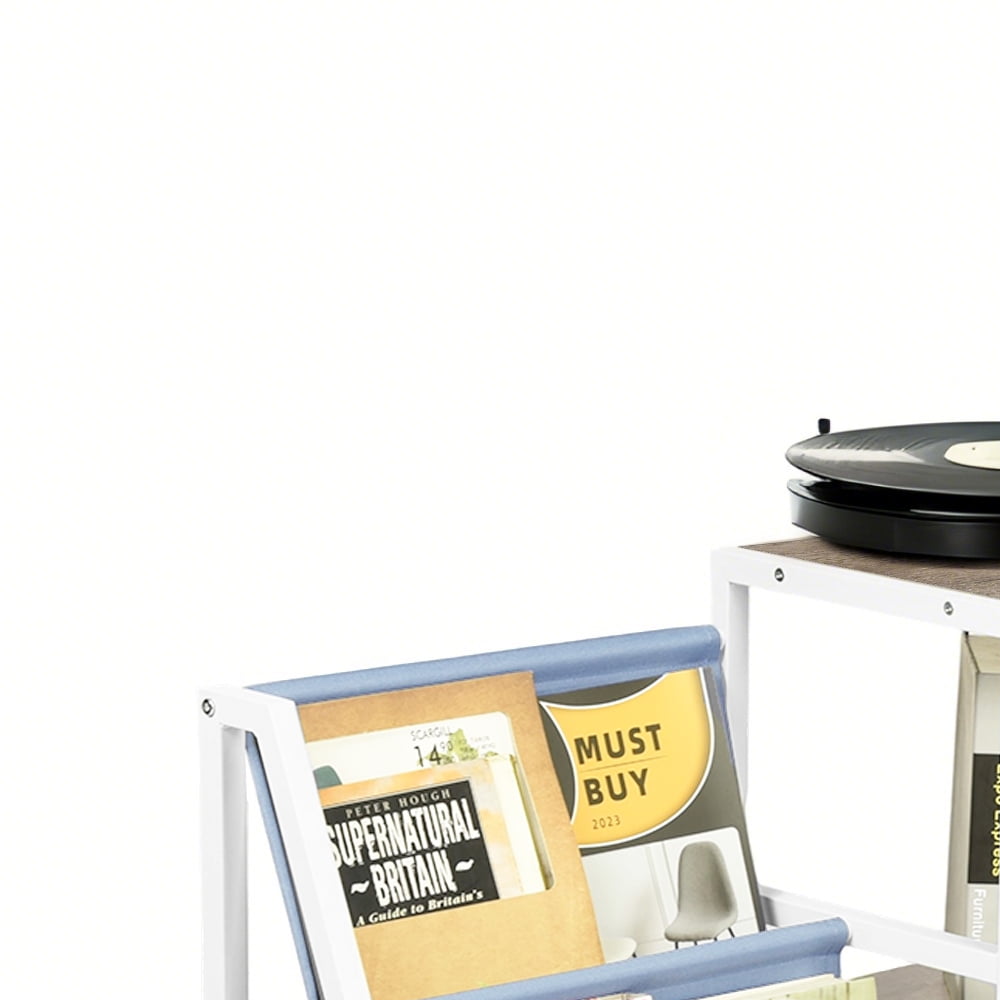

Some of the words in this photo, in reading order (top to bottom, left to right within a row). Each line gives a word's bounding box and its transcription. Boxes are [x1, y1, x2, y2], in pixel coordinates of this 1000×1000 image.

[574, 723, 661, 765] MUST
[345, 801, 391, 818] PETER
[399, 789, 451, 807] HOUGH
[584, 768, 648, 806] BUY
[326, 798, 480, 869] SUPERNATURAL
[592, 815, 621, 830] 2023
[370, 850, 458, 907] BRITAIN
[356, 916, 365, 927] A
[369, 907, 407, 923] Guide
[411, 902, 425, 914] to
[428, 889, 485, 910] Britain's
[972, 889, 986, 942] Furnitu
